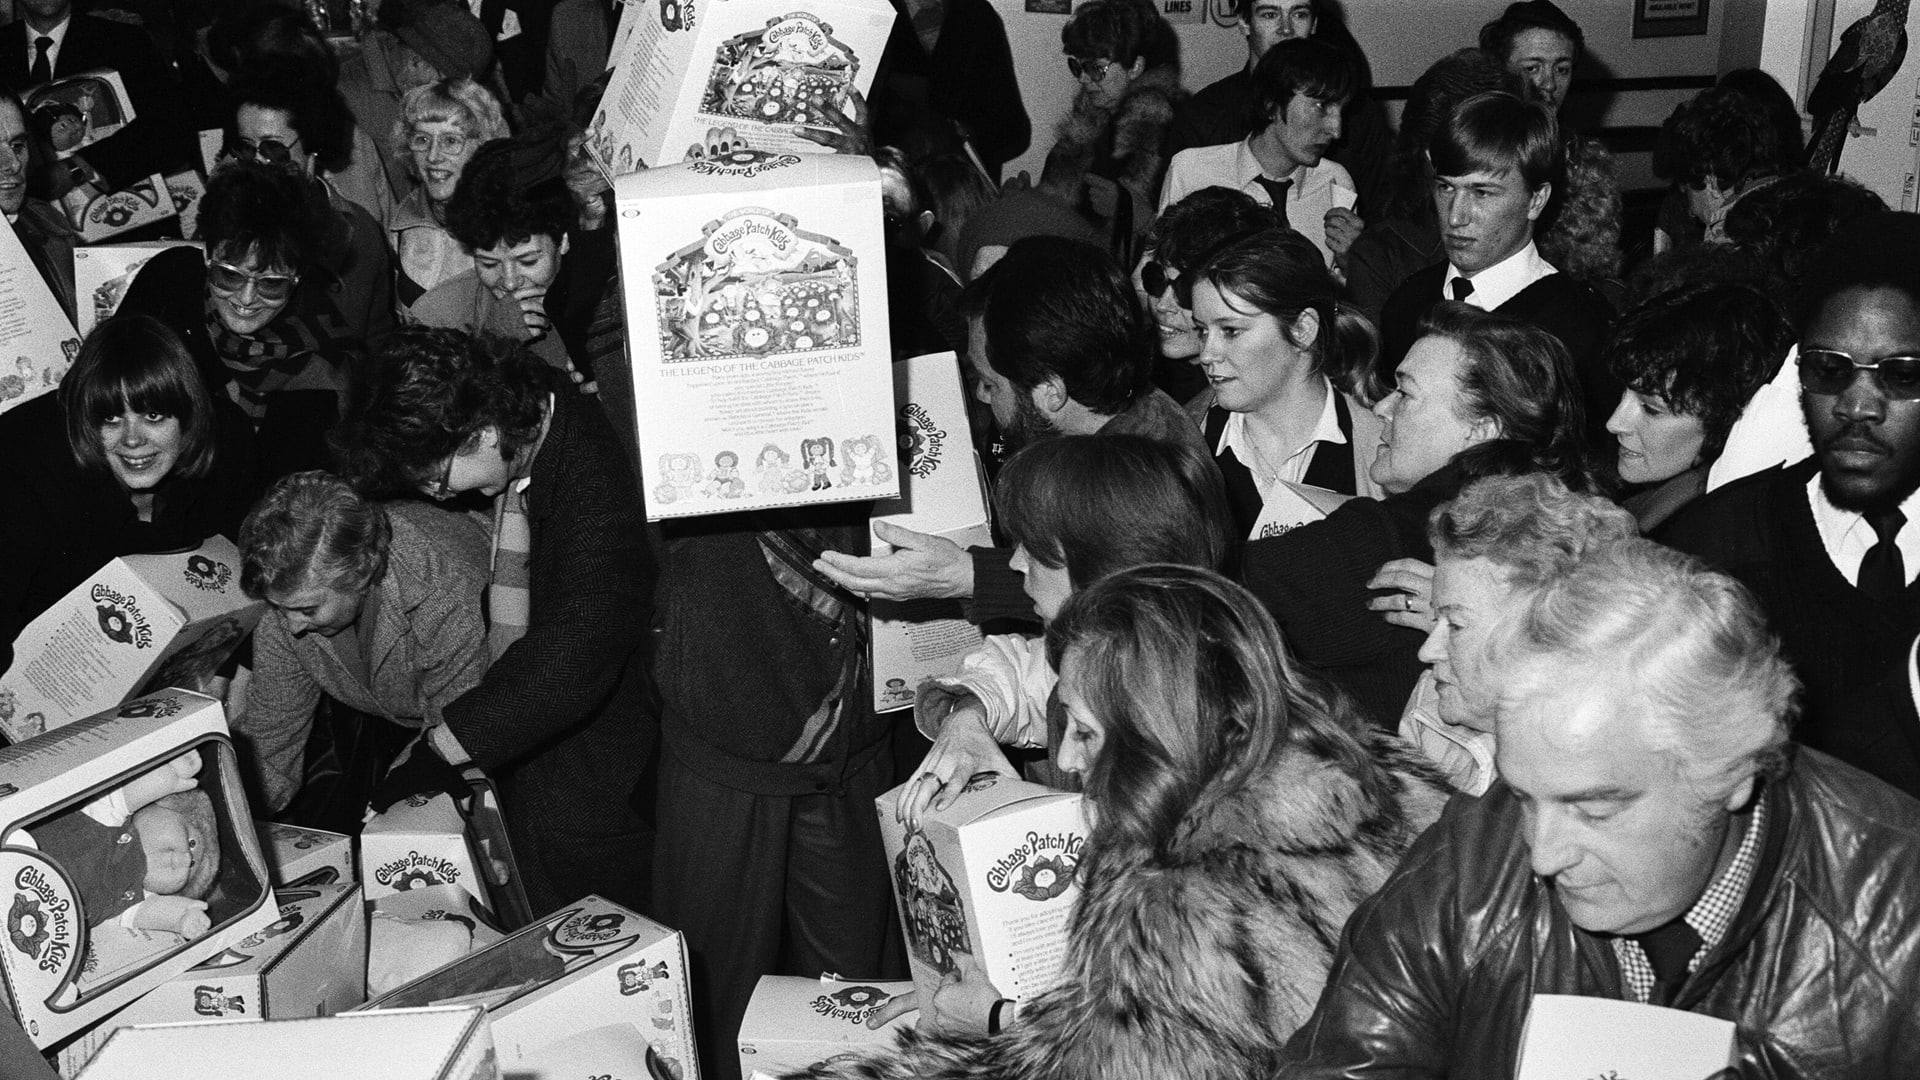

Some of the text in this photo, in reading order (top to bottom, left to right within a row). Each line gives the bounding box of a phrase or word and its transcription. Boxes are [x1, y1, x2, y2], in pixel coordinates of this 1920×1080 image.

[1164, 0, 1191, 13] LINES
[712, 219, 791, 255] Cabbage Patch Kids
[660, 368, 680, 378] THE
[681, 365, 722, 377] LEGEND
[723, 364, 737, 374] OF
[739, 362, 757, 373] THE
[760, 358, 803, 371] CABBAGE
[807, 355, 836, 366] PATCH
[900, 403, 936, 433] Cabbage
[926, 430, 947, 457] Patch
[91, 583, 152, 650] Cabbage Patch Kids
[375, 850, 461, 886] Cabbage Patch Kids
[987, 831, 1084, 893] Cabbage Patch Ki
[15, 865, 71, 975] Cabbage Patch Kids
[831, 1007, 863, 1025] Patch
